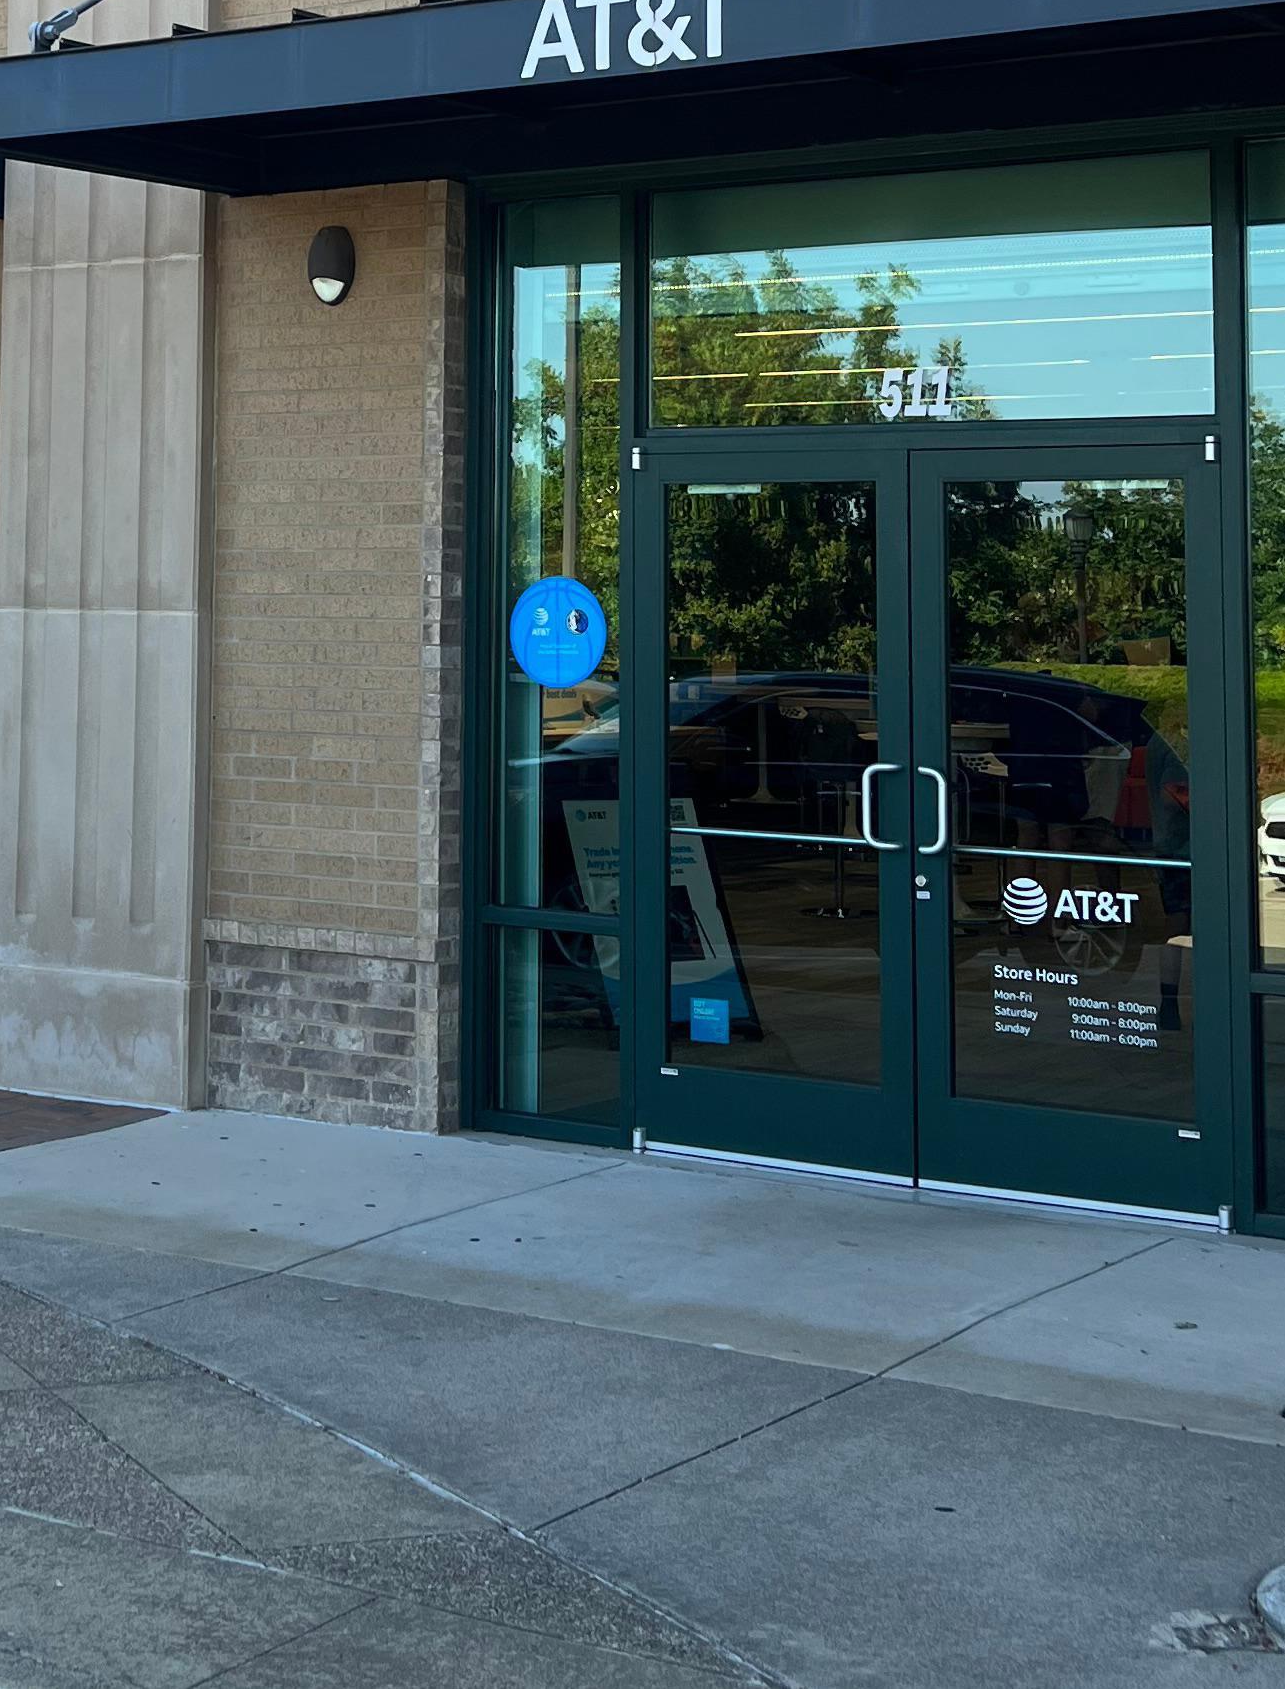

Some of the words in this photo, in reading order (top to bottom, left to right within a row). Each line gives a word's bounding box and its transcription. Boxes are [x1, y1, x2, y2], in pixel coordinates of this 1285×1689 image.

[879, 366, 951, 417] 511
[1054, 889, 1139, 923] AT&T
[994, 964, 1032, 981] Store
[1036, 968, 1079, 985] Hours
[994, 989, 1033, 1003] Mon-Fri
[1067, 996, 1110, 1010] 10:00am
[1118, 1001, 1157, 1015] 8:00pm
[994, 1006, 1039, 1021] Saturday
[1072, 1013, 1110, 1027] 9:00am
[994, 1022, 1031, 1037] Sunday
[1069, 1029, 1110, 1043] 11:00am
